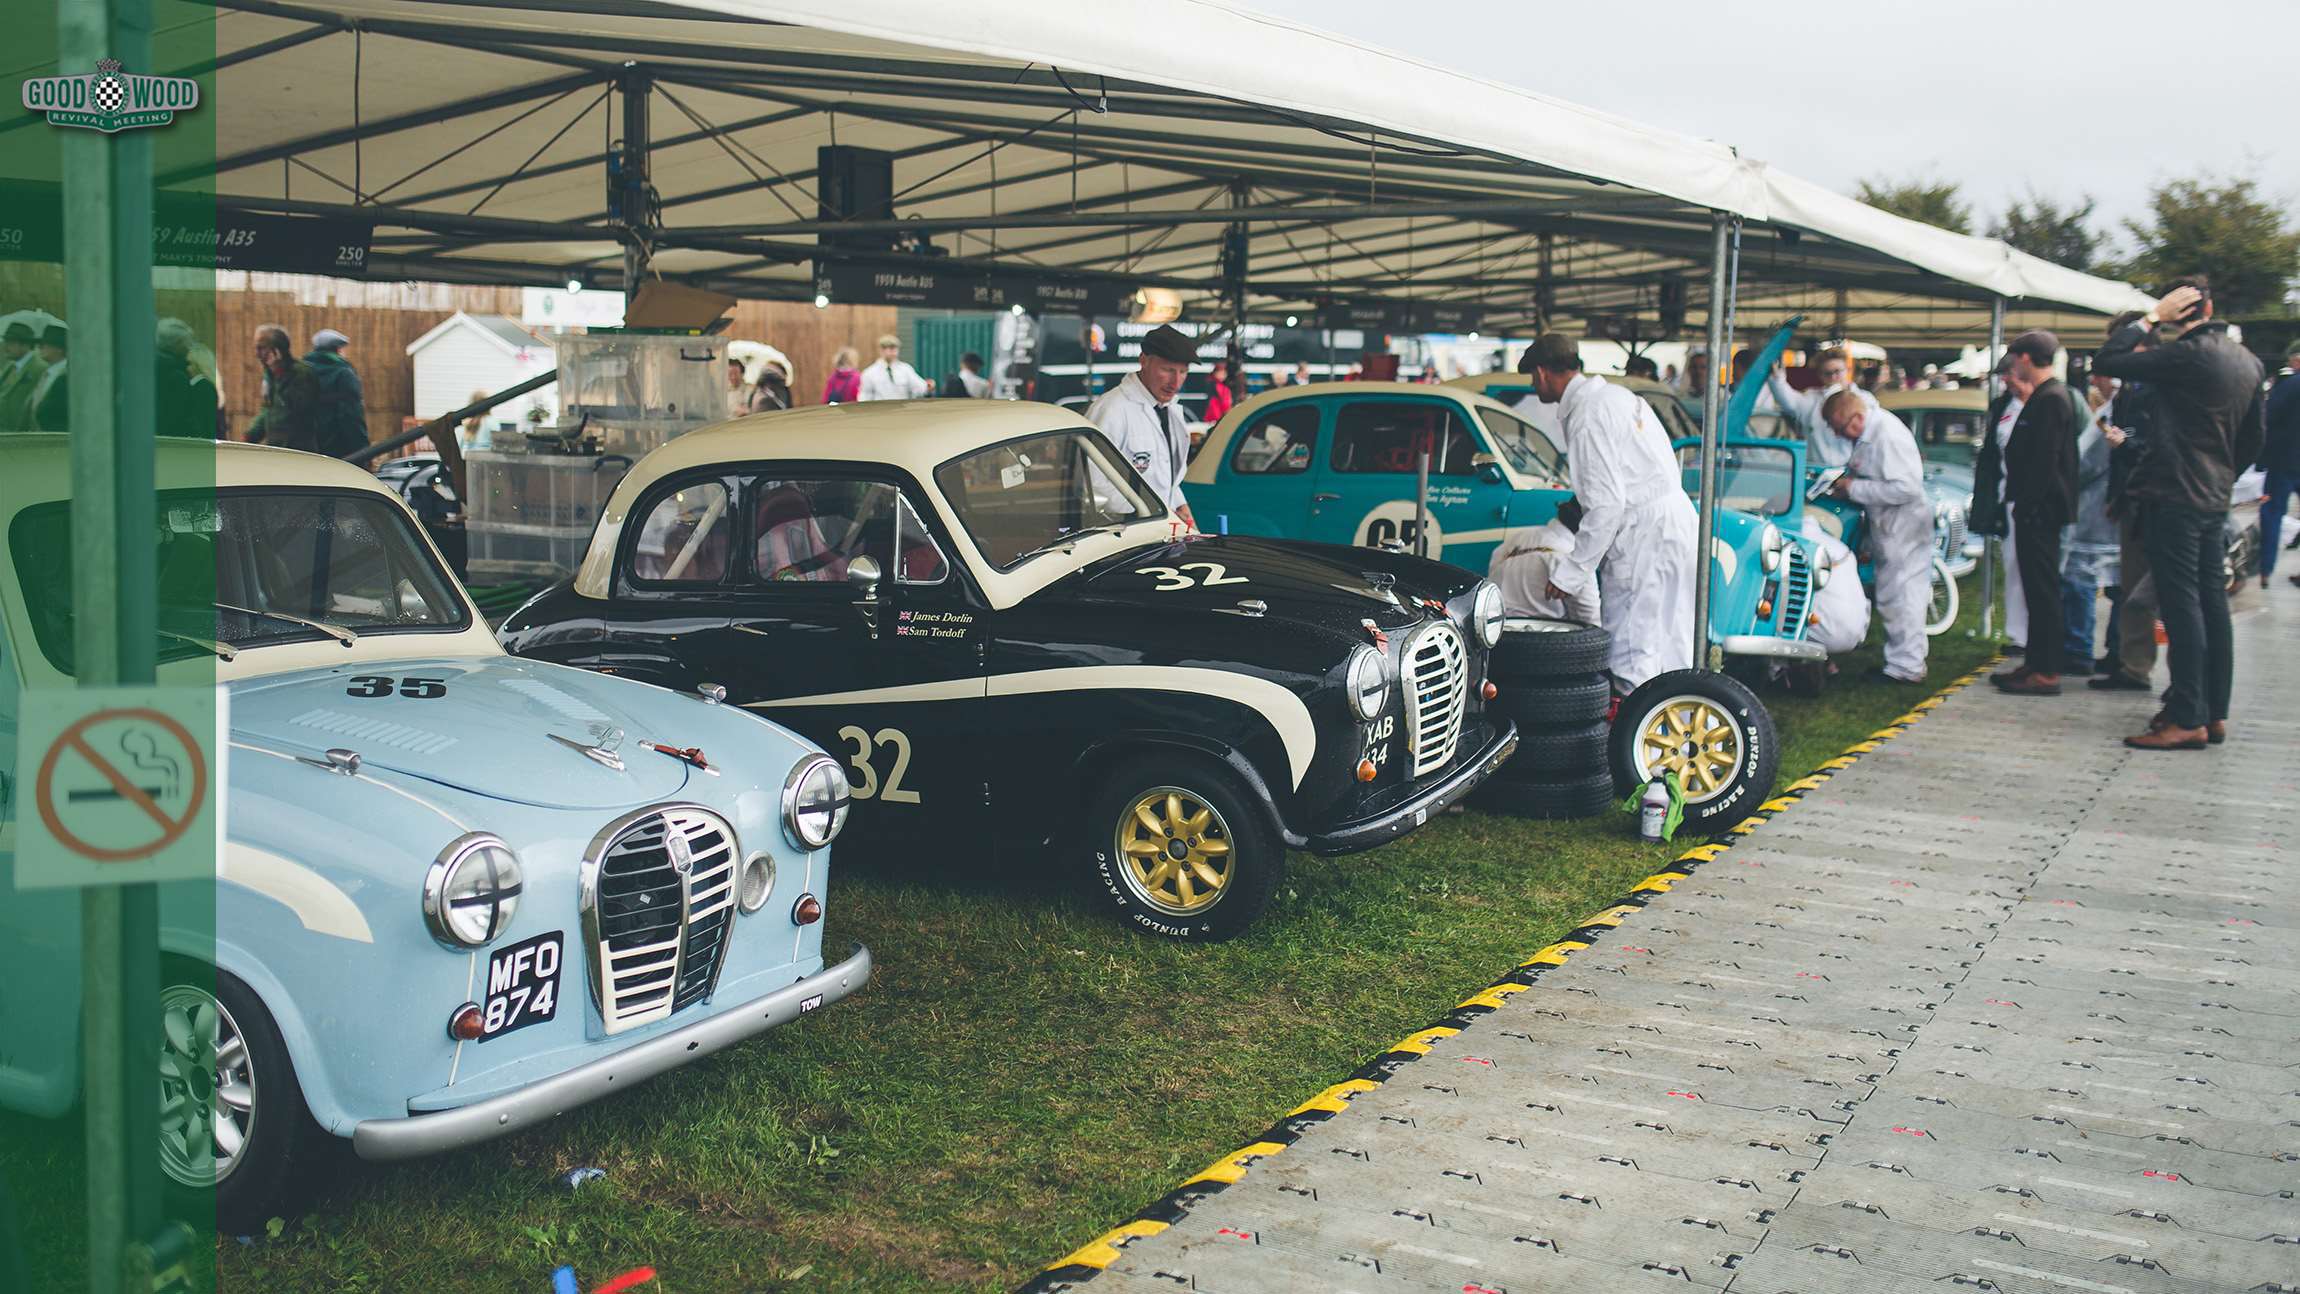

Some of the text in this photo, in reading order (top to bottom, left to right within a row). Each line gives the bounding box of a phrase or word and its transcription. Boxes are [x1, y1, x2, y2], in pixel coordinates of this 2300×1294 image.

[0, 228, 23, 244] 50
[151, 227, 171, 244] 59
[223, 229, 257, 247] A35
[337, 246, 364, 262] 250
[1135, 562, 1250, 591] 32
[910, 611, 973, 623] James Dorlin
[908, 626, 966, 638] Sam Tordoff
[346, 676, 447, 699] 35
[838, 725, 921, 804] 32
[1366, 743, 1388, 767] 34
[1702, 726, 1761, 818] DUNLOP RACING
[1096, 852, 1190, 936] DUNLOP RACING
[489, 940, 560, 996] MFO
[484, 980, 554, 1034] 874
[801, 995, 822, 1012] TOW
